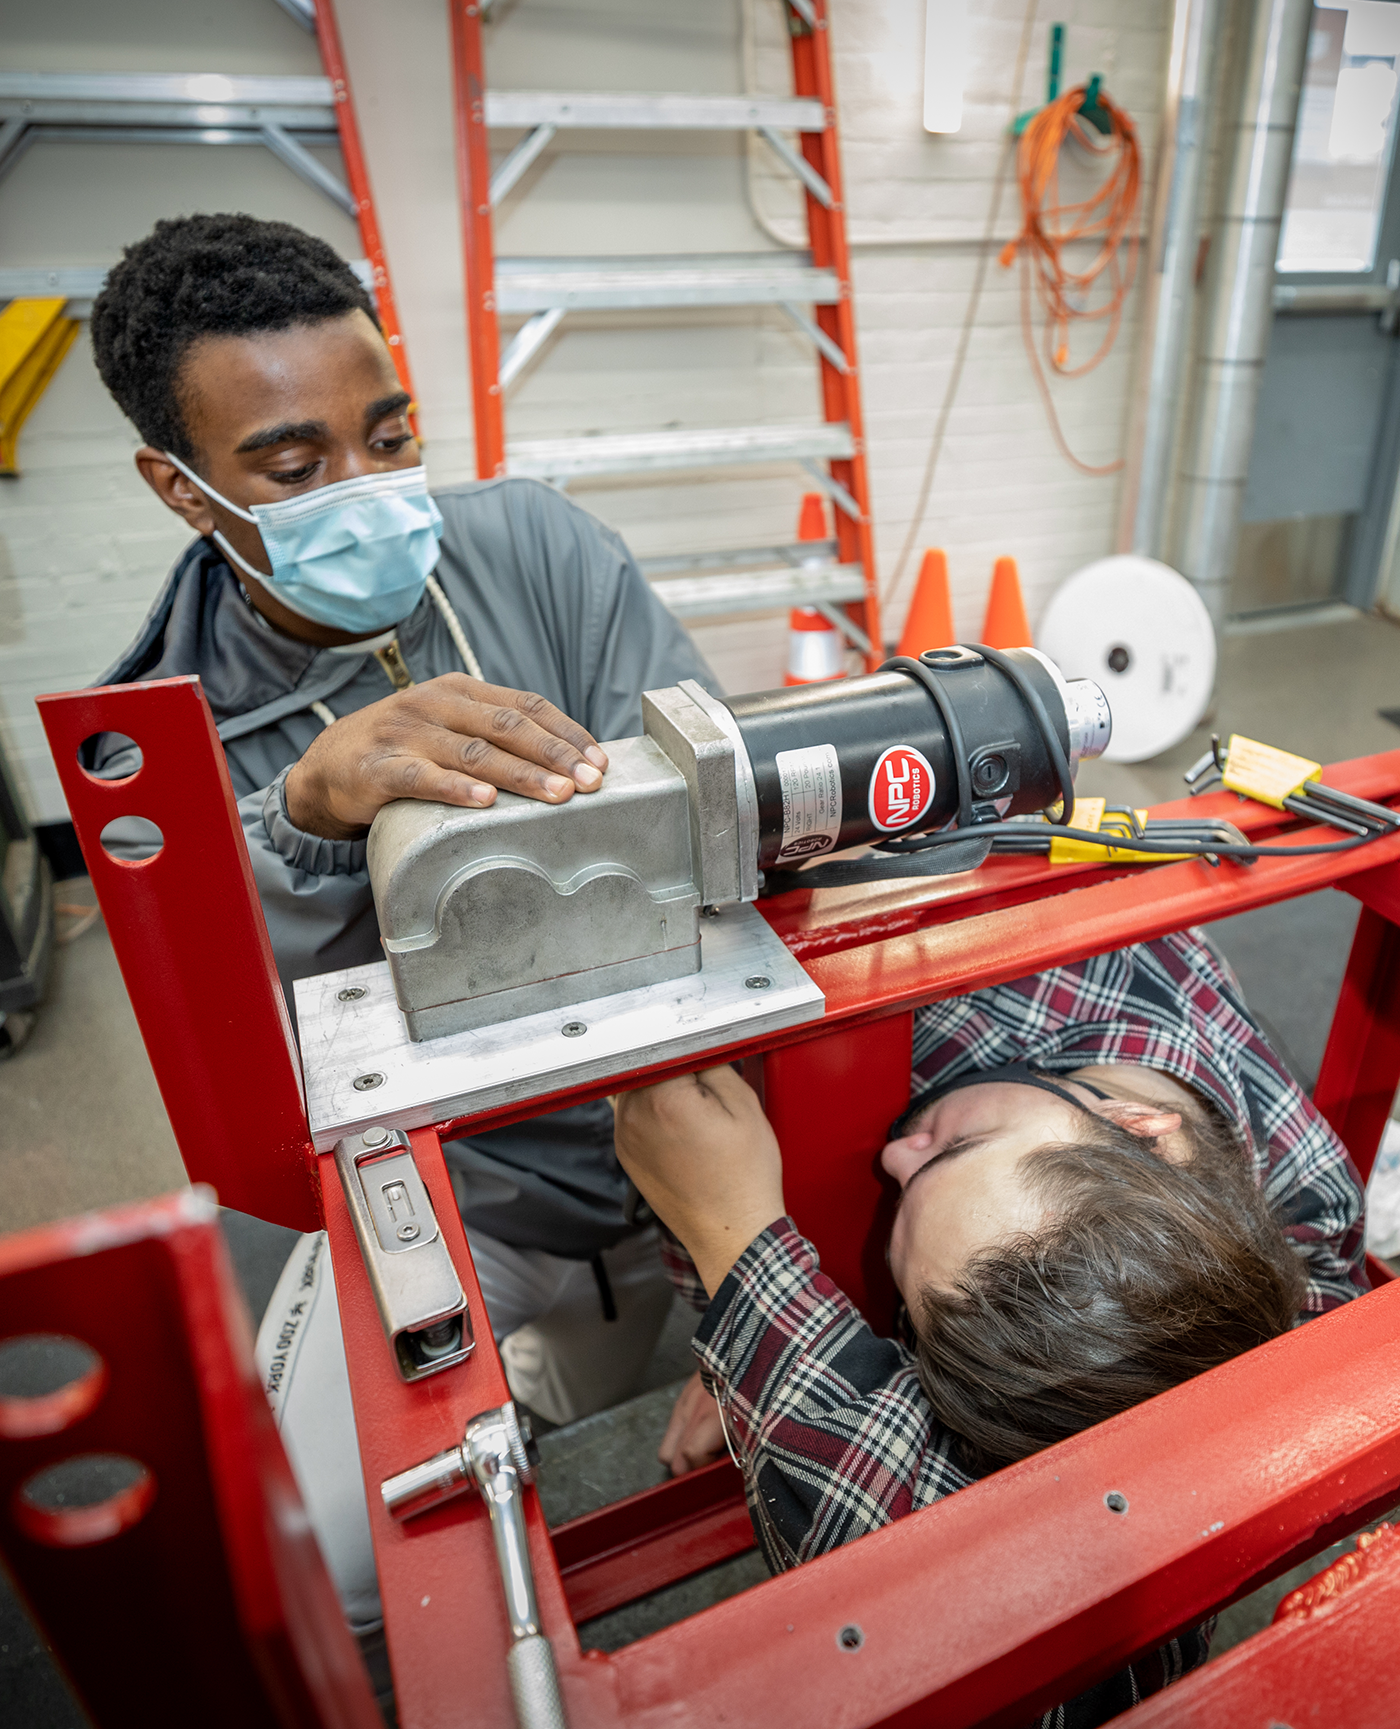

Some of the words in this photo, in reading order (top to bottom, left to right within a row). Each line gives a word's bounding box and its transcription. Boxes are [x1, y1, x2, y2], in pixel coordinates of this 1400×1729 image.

[804, 780, 811, 789] 20
[825, 752, 838, 817] NPCRoboticscom
[885, 758, 910, 824] NPC
[912, 768, 921, 811] ROBOTICS
[783, 838, 829, 856] NPC
[794, 826, 801, 834] 24
[276, 1320, 299, 1351] ZOO
[267, 1352, 288, 1393] YORK
